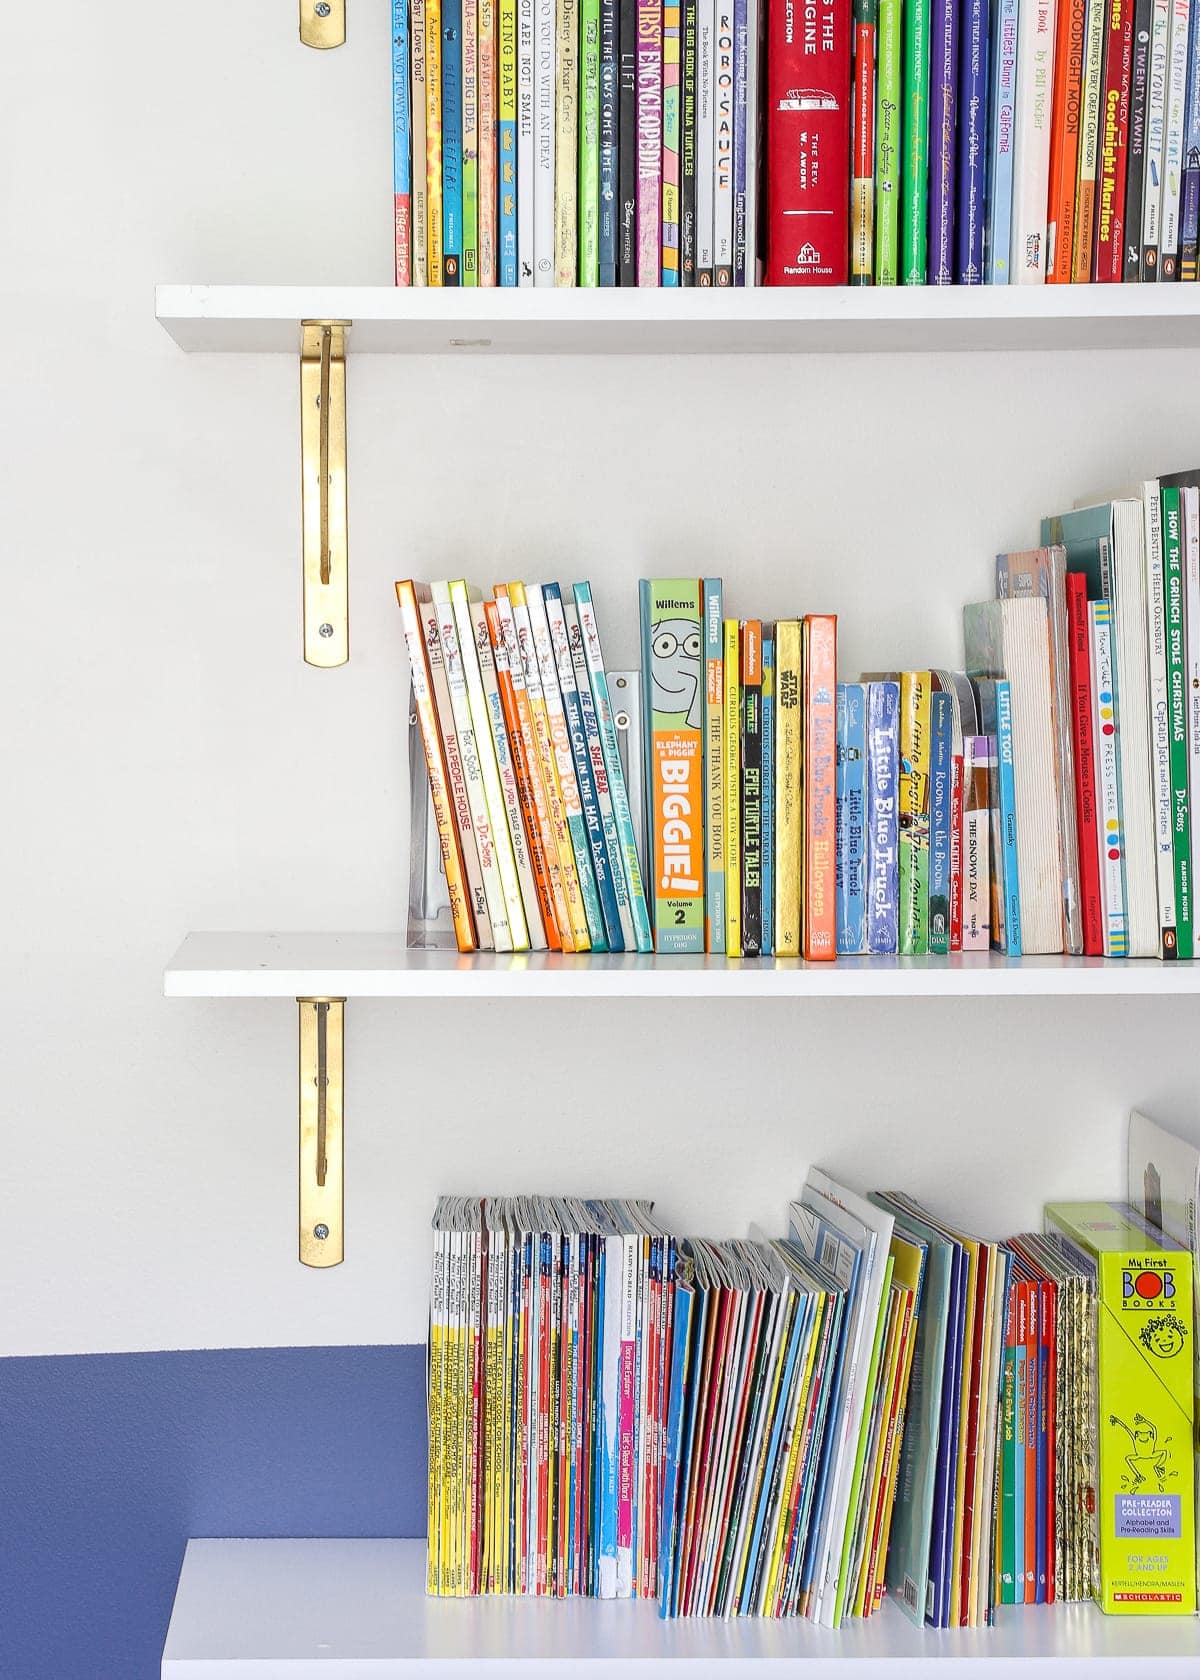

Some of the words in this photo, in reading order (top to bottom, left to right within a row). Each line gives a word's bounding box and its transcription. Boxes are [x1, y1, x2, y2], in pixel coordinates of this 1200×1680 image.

[561, 0, 574, 43] Disney
[603, 11, 613, 35] TILL
[686, 5, 695, 26] THE
[1037, 9, 1049, 34] Book
[1092, 2, 1103, 23] KING
[502, 12, 513, 55] KING
[521, 22, 531, 46] ARE
[540, 21, 550, 47] YOU
[686, 29, 695, 47] BIG
[822, 12, 834, 51] THE
[1068, 0, 1084, 84] GOODNIGHT
[1091, 25, 1102, 66] ARTHUR'S
[540, 50, 550, 70] DO
[603, 40, 613, 61] THE
[685, 50, 695, 77] BOOK
[502, 64, 514, 110] BABY
[562, 58, 573, 92] Pixar
[603, 66, 613, 98] COWS
[622, 54, 634, 90] LIFT
[685, 80, 694, 93] OF
[1088, 69, 1100, 90] VERY
[1135, 46, 1147, 101] TWENTY
[466, 76, 476, 100] BIG
[540, 75, 551, 108] WITH
[718, 15, 732, 191] ROBO-SAUCE
[466, 102, 476, 134] IDEA
[521, 93, 531, 137] SMALL
[540, 112, 551, 131] AN
[562, 95, 573, 123] Cars
[603, 104, 613, 135] COME
[638, 50, 661, 180] ENCYCLOPEDIA
[685, 96, 694, 127] NINJA
[1066, 89, 1078, 134] MOON
[1087, 92, 1098, 121] GREAT
[1086, 123, 1097, 168] GRANDSON
[1103, 90, 1120, 173] Goodnight
[1133, 109, 1143, 155] YAWNS
[540, 135, 550, 169] IDEA?
[602, 141, 613, 173] HOME
[684, 131, 694, 176] TURTLES
[396, 207, 408, 239] tiger
[735, 192, 746, 244] Tanglewood
[1100, 178, 1115, 242] Marines
[1061, 201, 1071, 275] HARPERCOLLINS
[737, 247, 746, 271] Press
[784, 266, 811, 275] Random
[812, 266, 833, 275] House
[1150, 496, 1159, 522] PETER
[1168, 511, 1179, 540] HOW
[1151, 527, 1160, 561] BENTLY
[1170, 547, 1180, 570] THE
[1153, 573, 1162, 603] HELEN
[1170, 576, 1181, 624] GRINCH
[655, 599, 695, 610] Willems
[709, 595, 720, 644] Willems
[1153, 606, 1164, 656] OXENBURY
[1171, 630, 1182, 665] STOLE
[581, 691, 591, 706] HE
[780, 670, 789, 709] WARS
[789, 670, 798, 709] STAR
[568, 703, 579, 727] THE
[1000, 691, 1012, 730] LITTLE
[1155, 702, 1169, 742] Captain
[1172, 671, 1185, 742] CHRISTMAS
[460, 729, 474, 747] Fox
[550, 712, 570, 753] HOP
[574, 733, 585, 755] CAT
[711, 716, 721, 742] THE
[590, 745, 601, 766] SHE
[656, 741, 698, 750] ELEPHANT
[874, 727, 894, 790] Little
[1002, 733, 1013, 765] TOOT
[1105, 743, 1114, 778] PRESS
[1157, 744, 1168, 767] Jack
[449, 755, 465, 795] PEOPLE
[464, 755, 480, 781] Socks
[578, 761, 587, 774] IN
[595, 770, 608, 794] BEAR
[711, 746, 722, 790] THANK
[745, 768, 760, 796] EPIC
[814, 755, 831, 783] Blue
[1160, 769, 1168, 783] and
[559, 773, 580, 810] POP
[583, 779, 593, 801] THE
[935, 770, 946, 806] Room
[1106, 783, 1115, 812] HERE
[1161, 784, 1169, 797] the
[456, 795, 471, 831] HOUSE
[585, 805, 599, 832] HAT
[712, 792, 722, 820] YOU
[814, 785, 832, 836] Truck's
[850, 788, 862, 822] Little
[875, 797, 894, 844] Blue
[934, 810, 944, 826] on
[1159, 799, 1171, 835] Pirates
[603, 813, 615, 835] The
[661, 759, 699, 893] BIGGIE!
[745, 799, 760, 846] TURTLE
[969, 819, 978, 838] THE
[1007, 813, 1016, 847] Gramatky
[592, 841, 603, 855] Dr.
[712, 825, 722, 860] BOOK
[850, 825, 862, 854] Blue
[935, 830, 946, 848] the
[595, 857, 606, 881] Seuss
[608, 838, 628, 906] Berenstains
[625, 845, 643, 897] EASTMAN
[745, 849, 759, 887] TALES
[934, 852, 946, 889] Broom
[969, 839, 978, 880] SNOWY
[813, 839, 830, 917] Halloween
[850, 857, 862, 896] Truck
[875, 847, 894, 919] Truck
[969, 882, 978, 902] DAY
[1180, 860, 1188, 893] RANDOM
[475, 886, 486, 915] LeSieg
[667, 900, 693, 908] Volume
[1181, 896, 1189, 922] HOUSE
[674, 910, 686, 925] 2
[1129, 1258, 1142, 1270] My
[1145, 1258, 1168, 1267] First
[1122, 1271, 1176, 1299] BOB
[1029, 1291, 1037, 1335] nickelodeon
[622, 1450, 630, 1466] Read
[621, 1483, 629, 1501] Dora!
[1121, 1500, 1172, 1508] PRE-READER
[1121, 1508, 1172, 1517] COLLECTION
[1125, 1519, 1156, 1527] Alphabet
[1120, 1527, 1159, 1535] Pre-Reading
[1160, 1526, 1175, 1534] Skills
[1127, 1555, 1144, 1563] FOR
[1147, 1555, 1169, 1563] AGES
[1121, 1593, 1182, 1601] SCHOLASTIC
